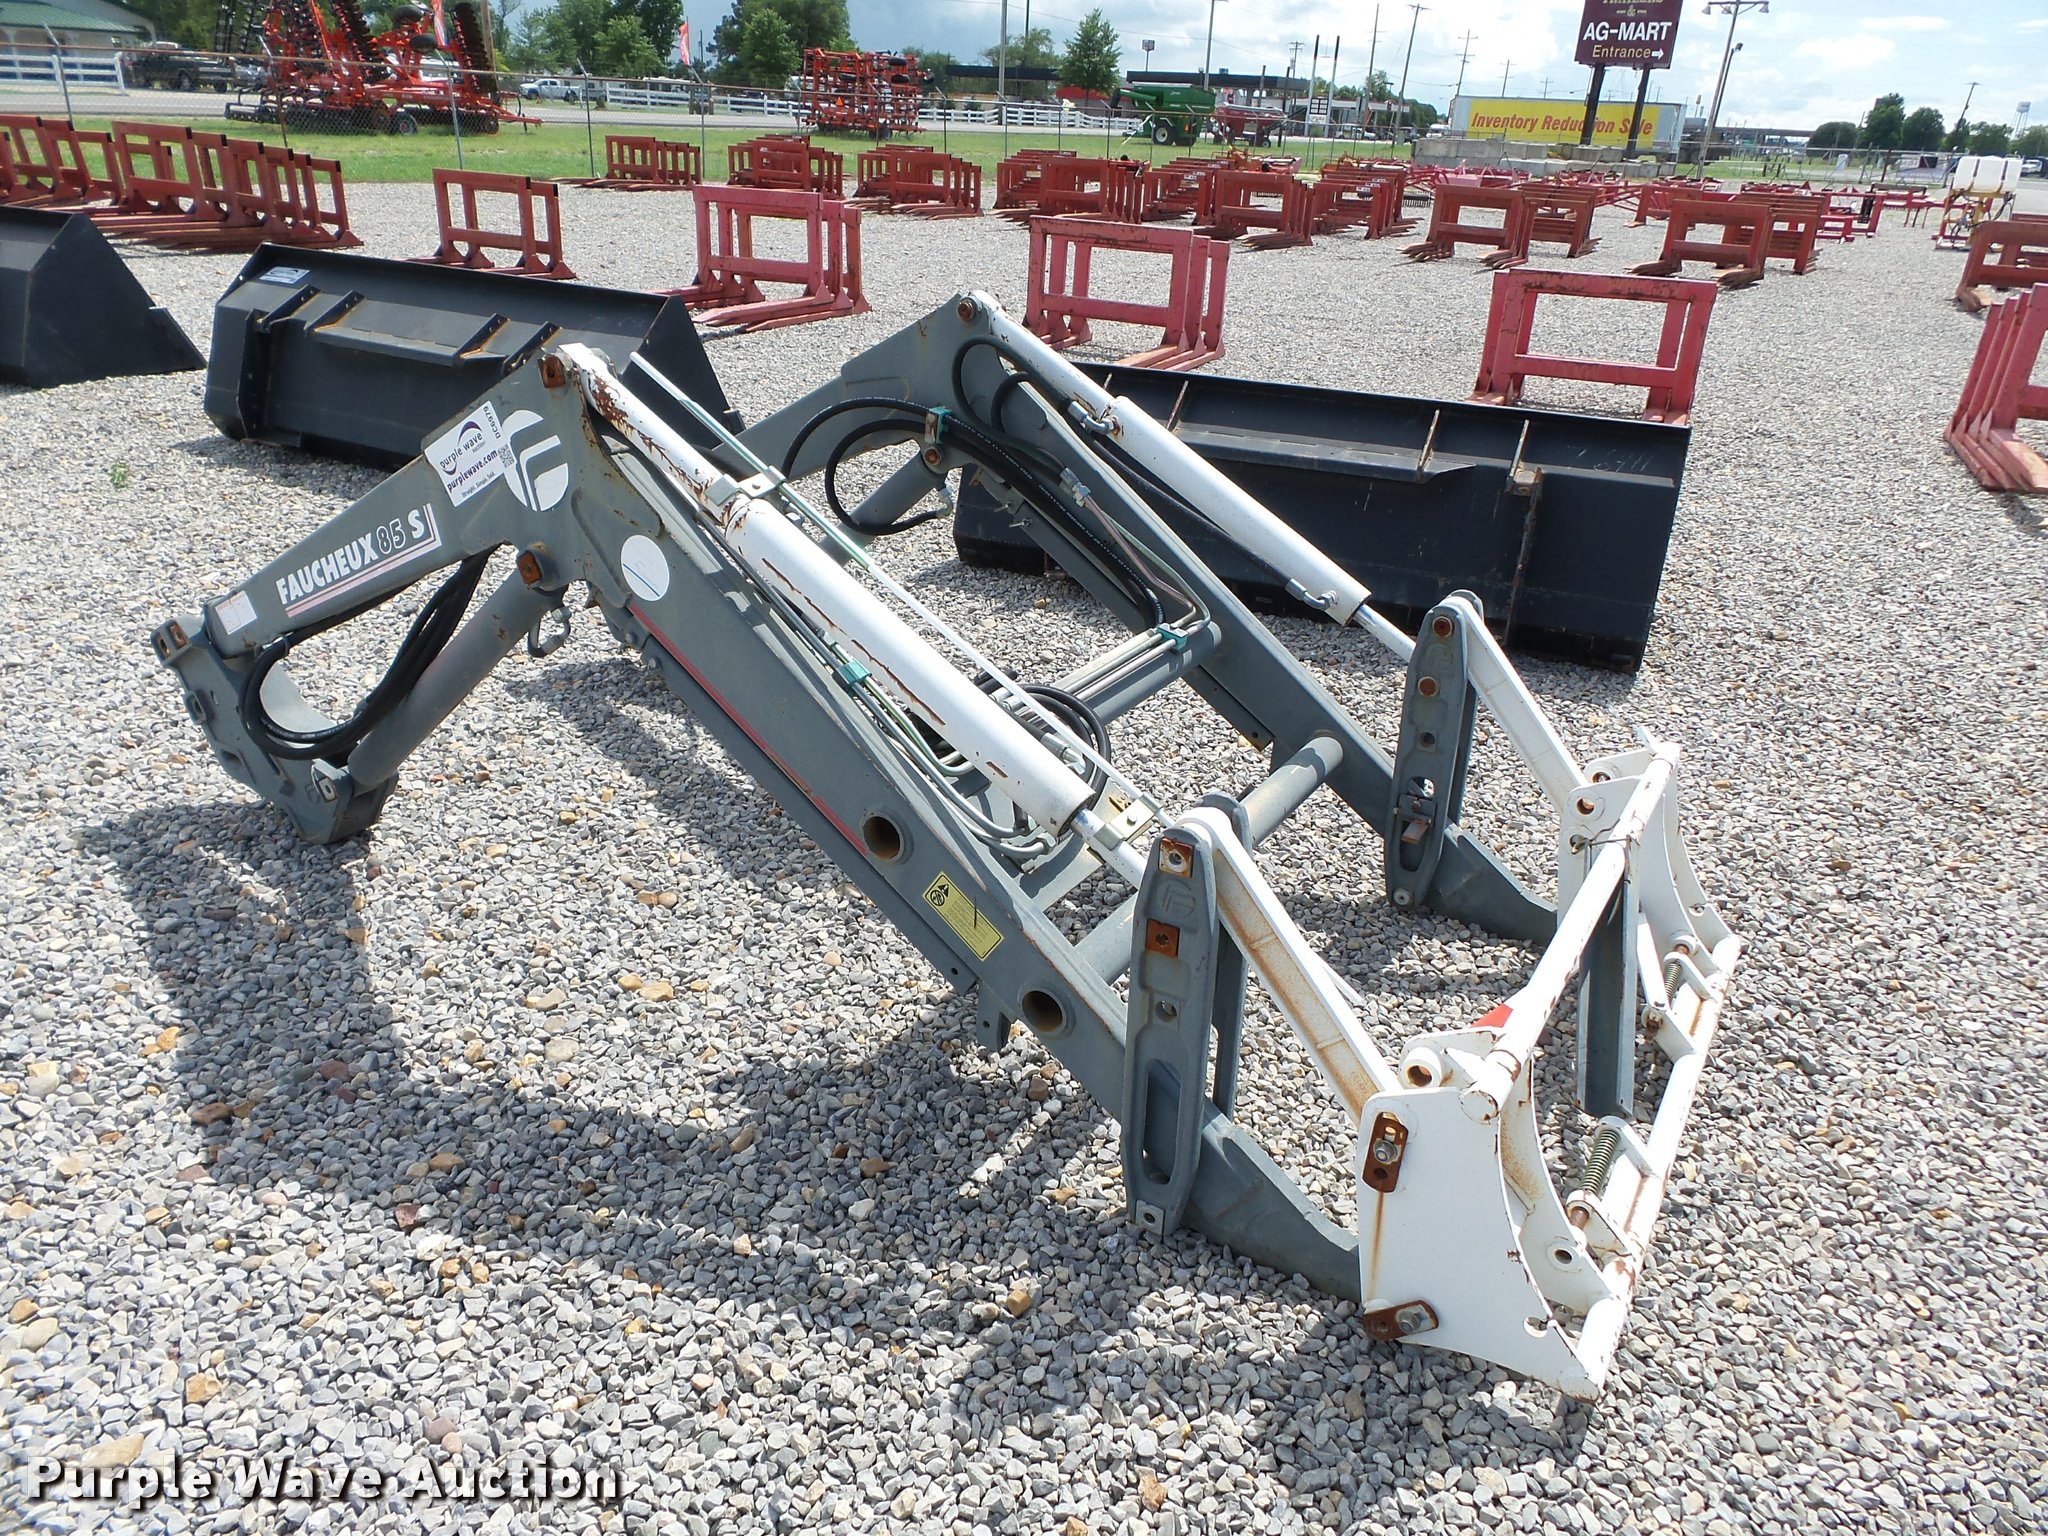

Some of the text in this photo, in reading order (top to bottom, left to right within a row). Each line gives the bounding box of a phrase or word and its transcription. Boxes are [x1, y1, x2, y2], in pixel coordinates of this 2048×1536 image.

[1583, 21, 1672, 41] AG-MART
[1592, 44, 1652, 58] Entrance
[1471, 112, 1653, 135] Inventory Reducion Sle
[440, 432, 483, 470] purple wave
[446, 449, 498, 493] purplewave.com
[275, 508, 425, 605] FAUCHEUX 85 S
